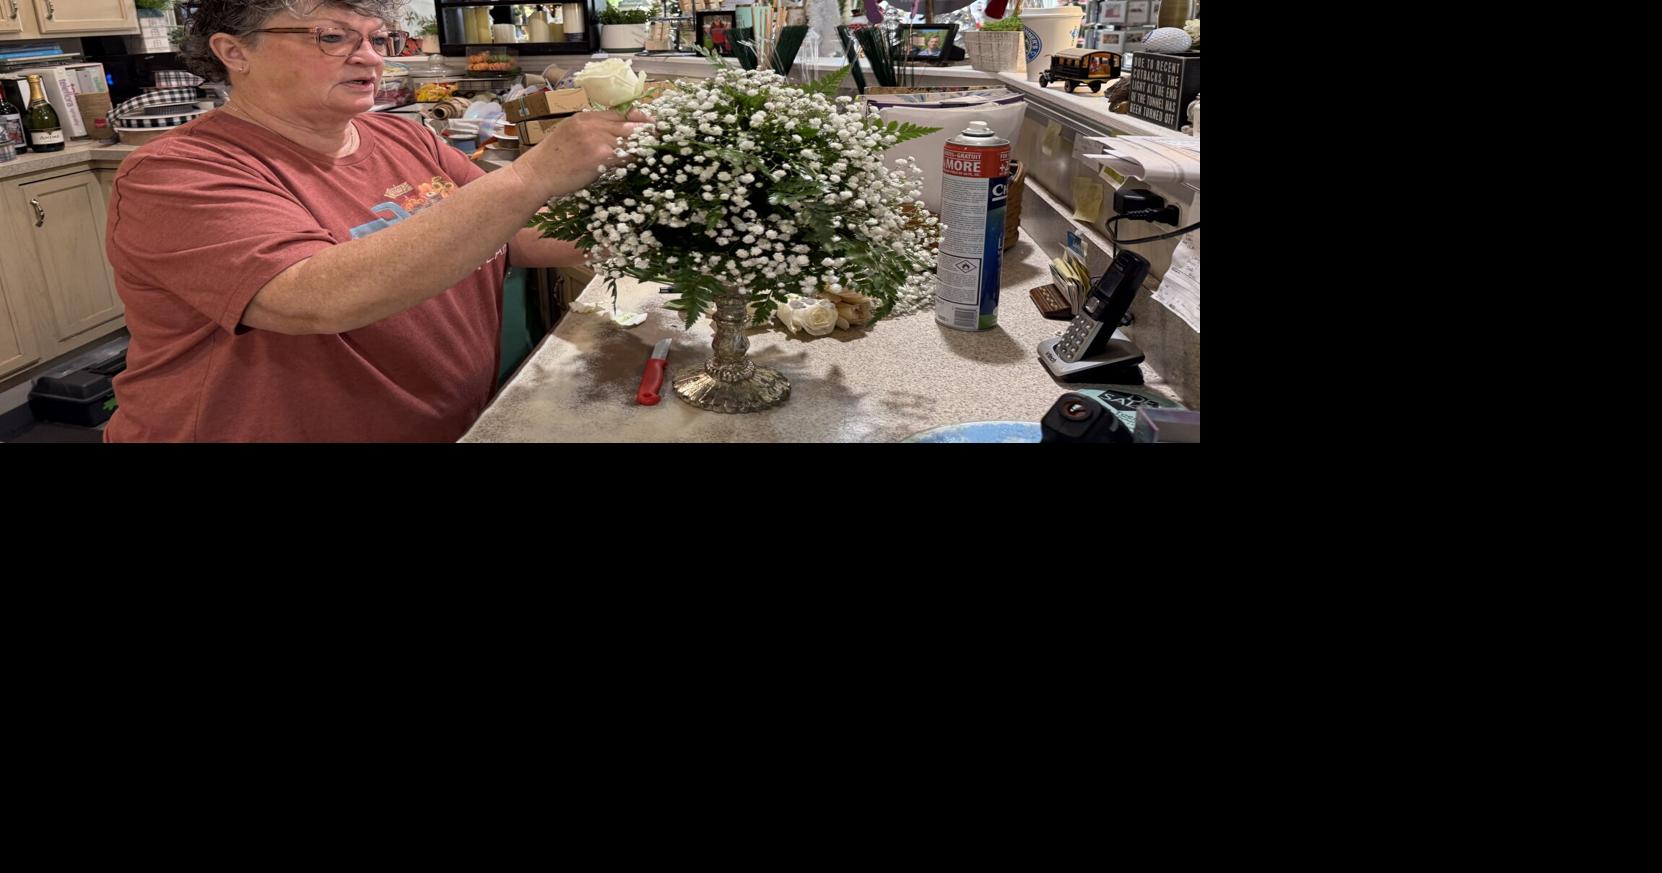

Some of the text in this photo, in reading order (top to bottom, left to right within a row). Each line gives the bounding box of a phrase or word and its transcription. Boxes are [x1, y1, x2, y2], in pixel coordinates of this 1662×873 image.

[1134, 56, 1180, 74] DUE TO RECENT
[1132, 79, 1178, 100] LIGHT AT THE END
[1167, 74, 1179, 87] THE
[1130, 91, 1176, 113] OF THE TUNNEL HAS
[1130, 103, 1175, 125] BEEN TURNED OFF
[945, 158, 981, 172] MORE
